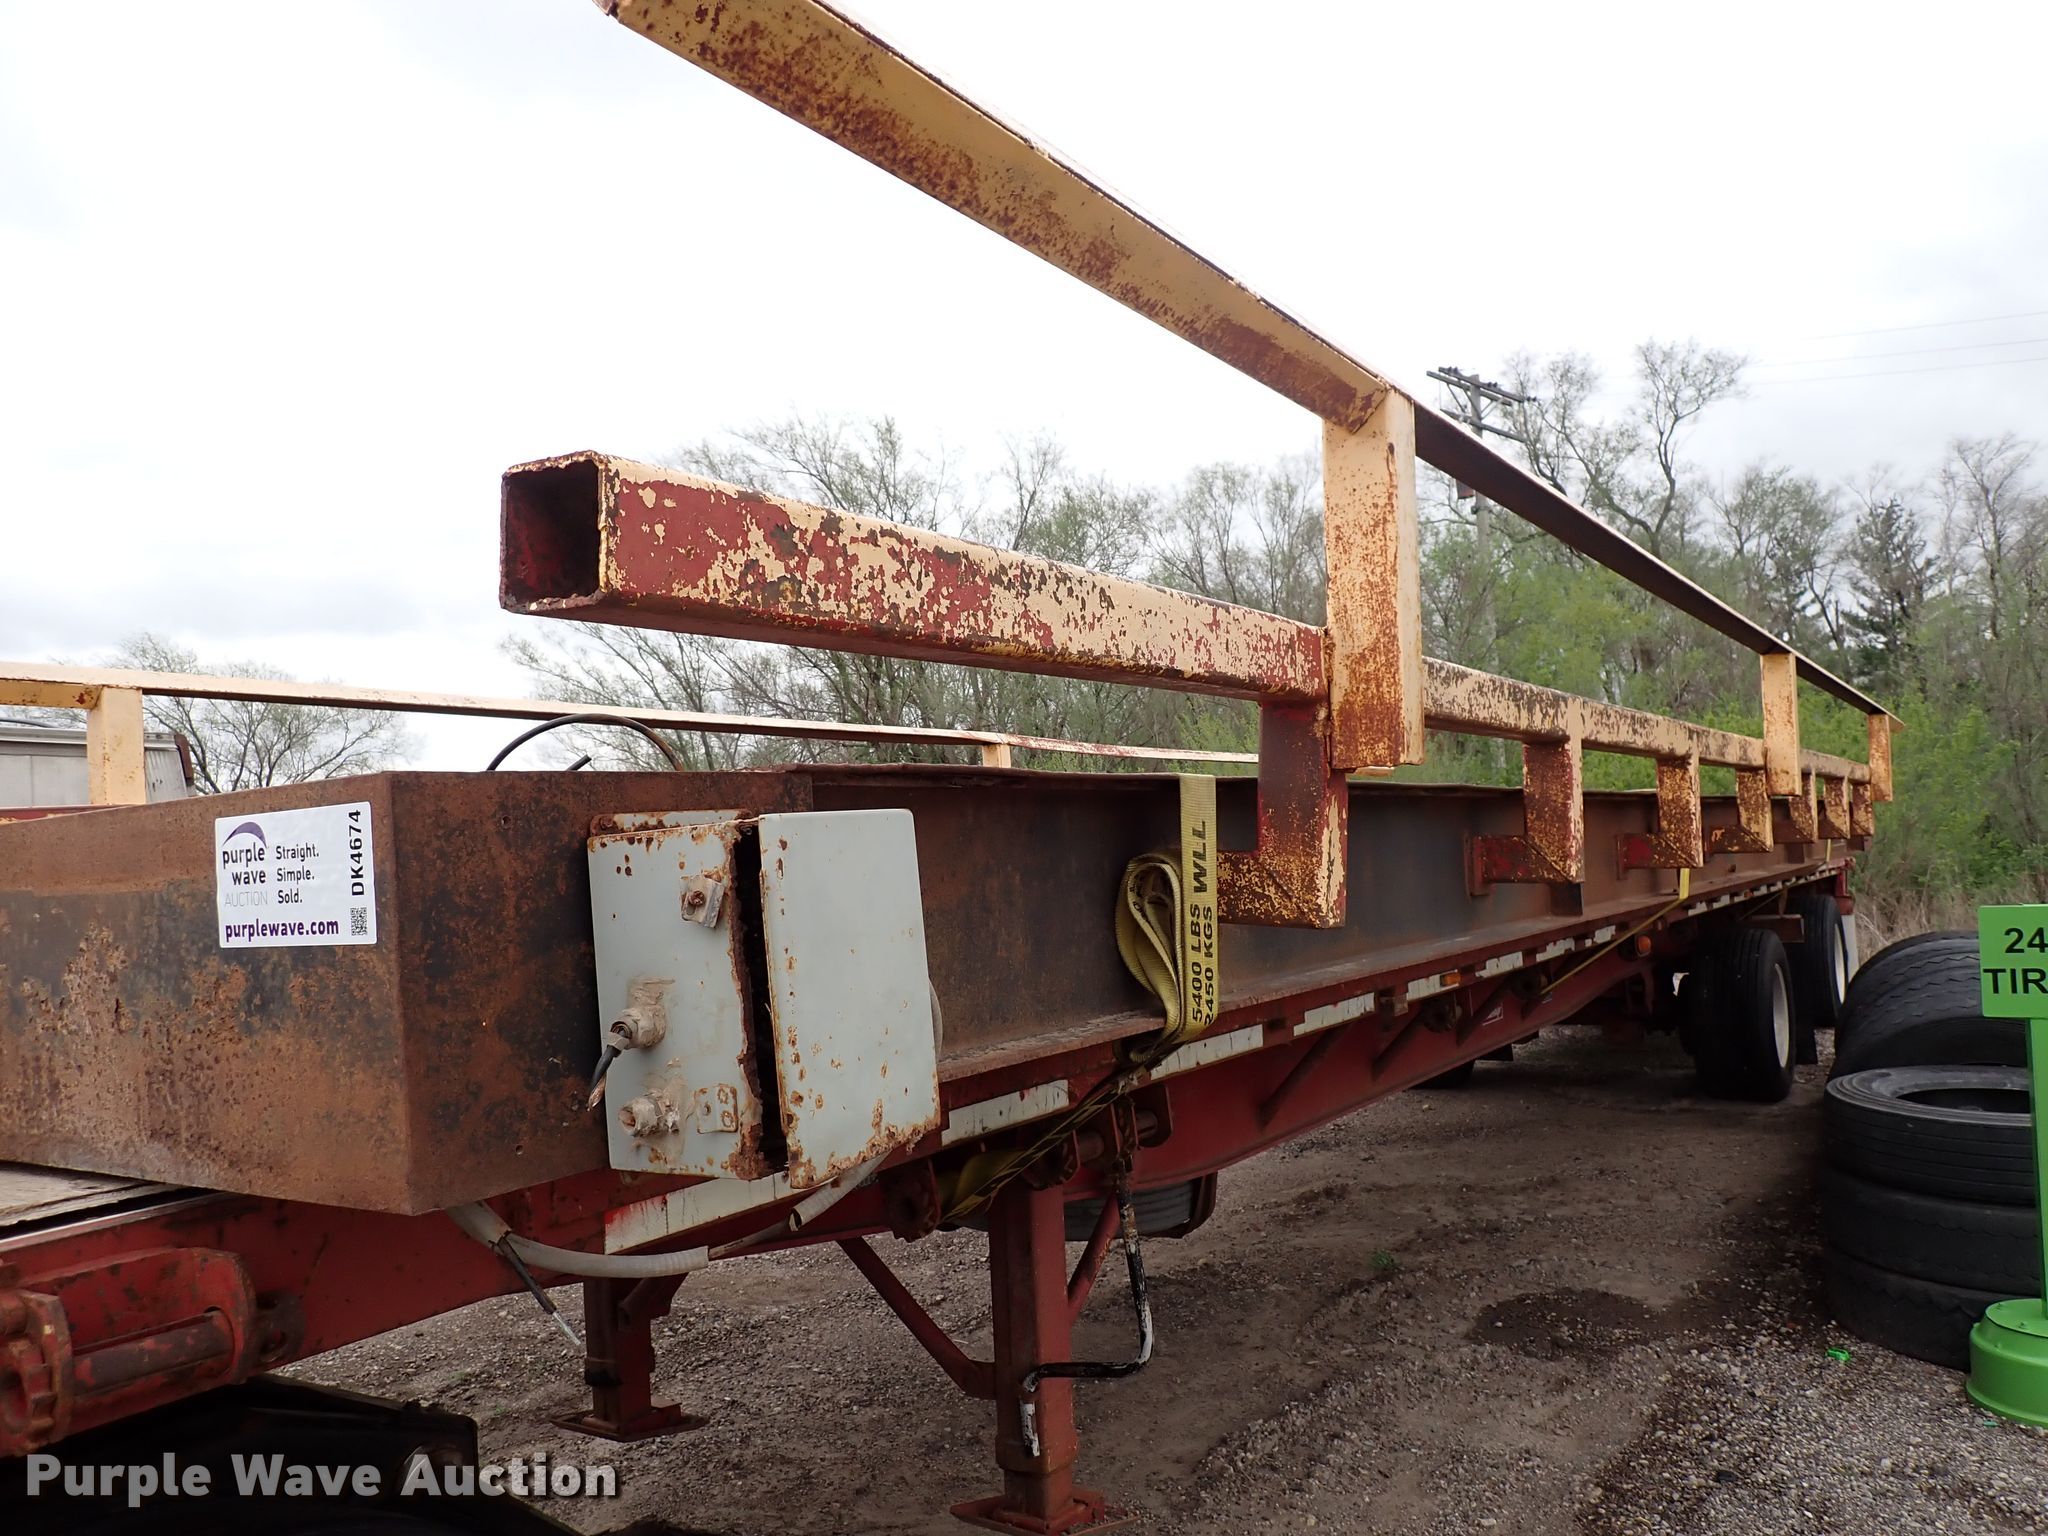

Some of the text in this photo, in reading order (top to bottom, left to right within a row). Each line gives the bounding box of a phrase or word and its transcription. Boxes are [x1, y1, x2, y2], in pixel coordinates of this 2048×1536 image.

[222, 842, 265, 869] purple
[276, 843, 319, 862] Straight.
[349, 809, 365, 896] DK4674
[1192, 820, 1208, 894] WLL
[232, 868, 266, 885] wave
[276, 866, 315, 885] Simple.
[225, 890, 268, 907] AUCTION
[277, 888, 303, 904] Sold.
[225, 918, 339, 943] purplewave.com
[2004, 927, 2048, 953] 24
[1190, 903, 1203, 1022] 5400 LBS
[1203, 906, 1215, 1026] 2450 KGS
